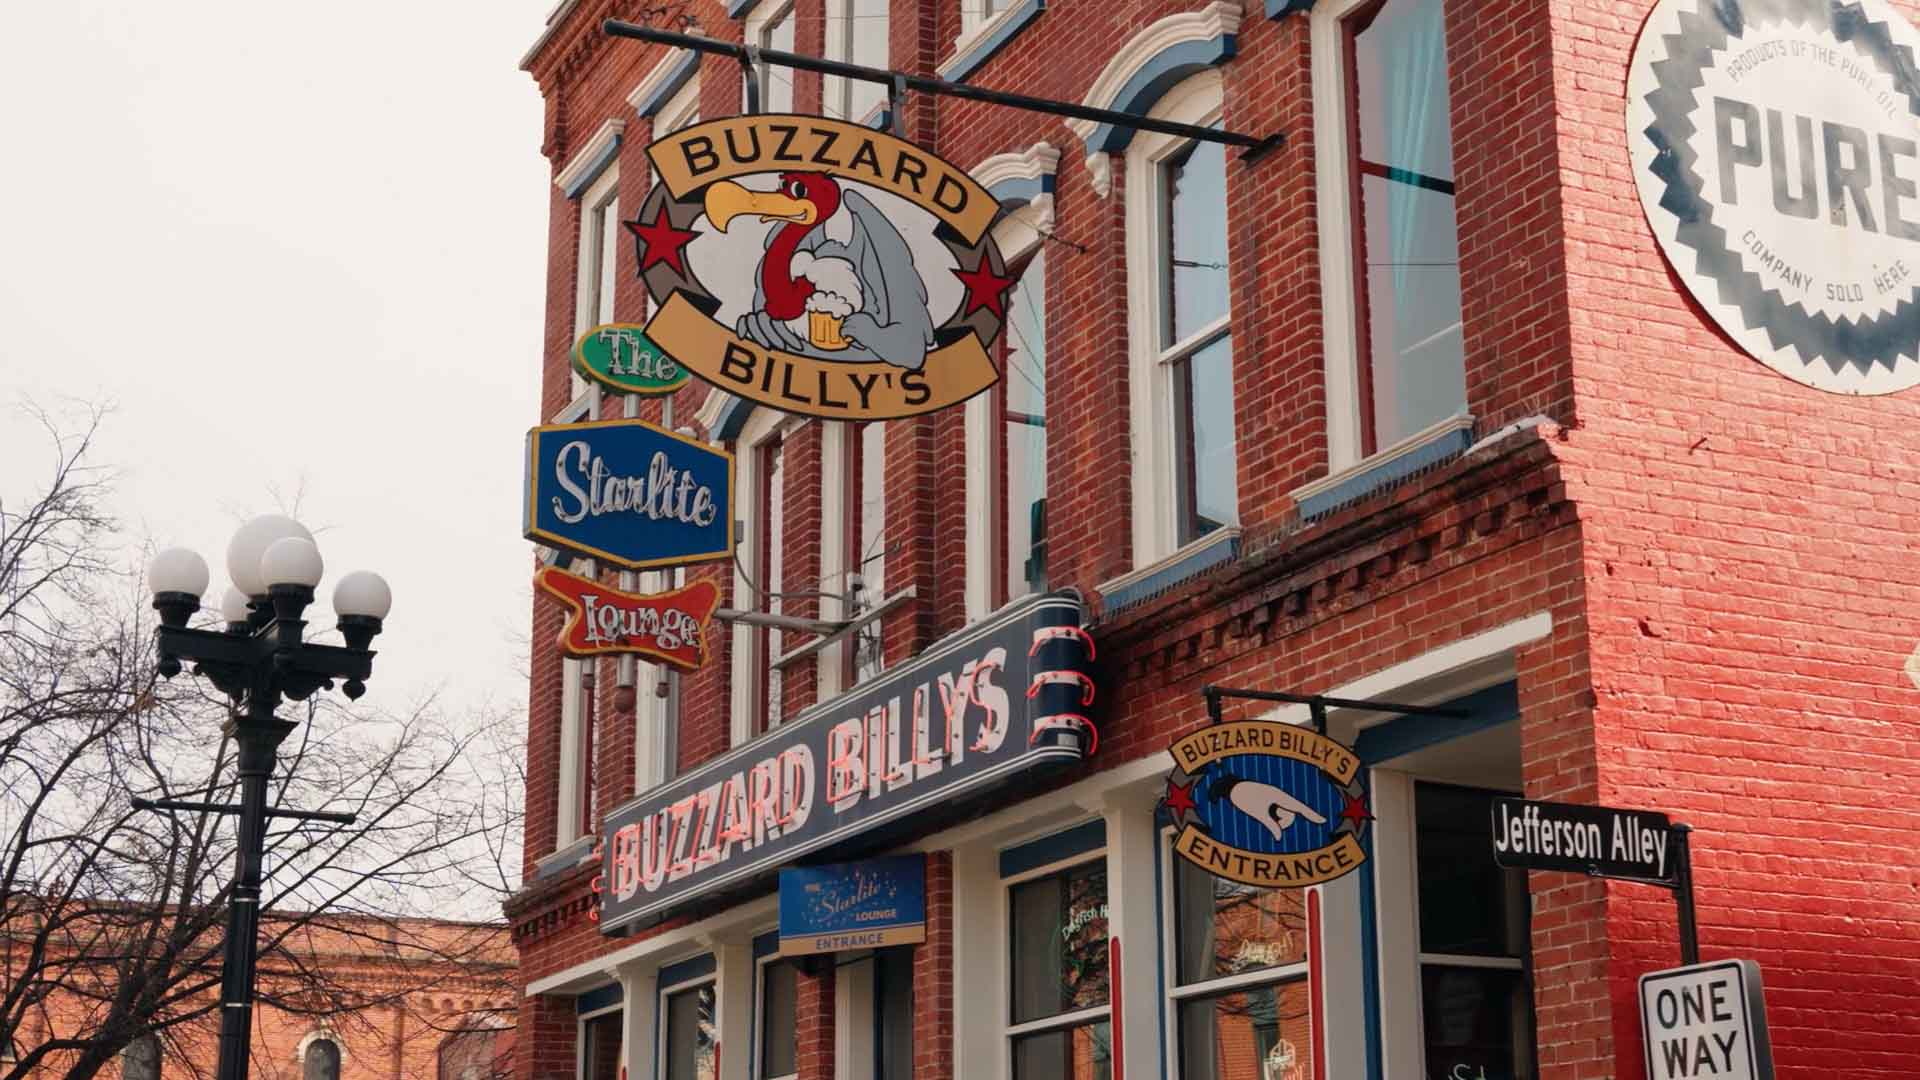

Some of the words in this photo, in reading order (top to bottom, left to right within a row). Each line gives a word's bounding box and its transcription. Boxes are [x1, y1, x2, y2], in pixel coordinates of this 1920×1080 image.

[1727, 40, 1787, 82] PRODUCTS
[1791, 40, 1807, 56] OF
[1810, 44, 1837, 67] THE
[680, 125, 968, 214] BUZZARD
[1713, 96, 1920, 242] PURE
[1742, 230, 1813, 293] COMPANY
[1826, 283, 1864, 302] SOLD
[1873, 259, 1911, 295] HERE
[599, 328, 678, 381] The
[720, 341, 932, 410] BILLY'S
[552, 440, 717, 527] Starlite
[580, 594, 701, 649] Lounge
[1182, 728, 1274, 764] BUZZARD
[1280, 731, 1352, 775] BILLY'S
[611, 743, 816, 903] BUZZARD
[1496, 804, 1602, 860] Jefferson
[1610, 815, 1668, 877] Alley
[1189, 836, 1353, 881] ENTRANCE
[816, 933, 884, 950] ENTRANCE
[856, 909, 897, 922] LOUNGE
[1656, 980, 1733, 1030] ONE
[1662, 1031, 1738, 1079] WAY
